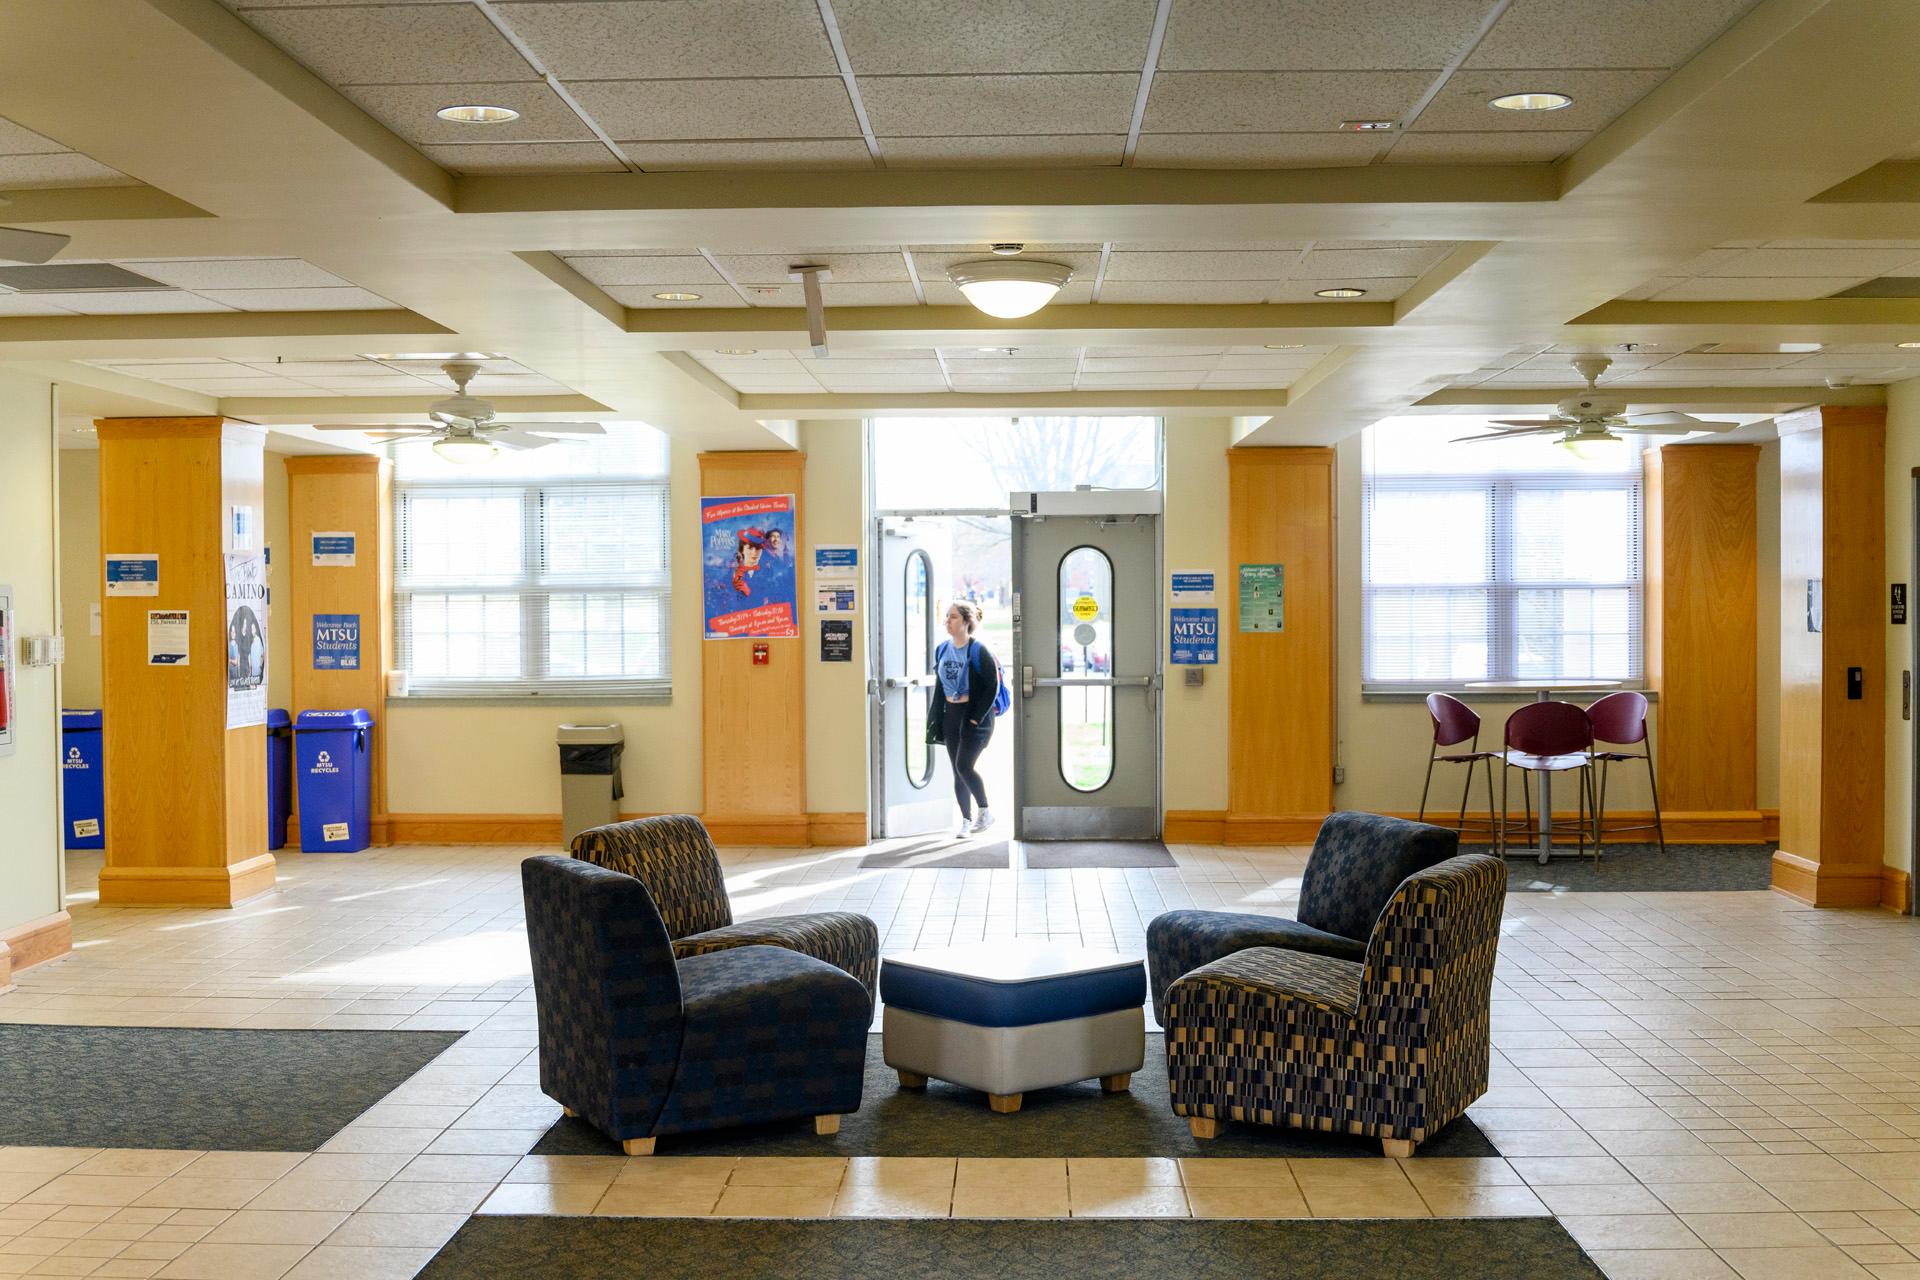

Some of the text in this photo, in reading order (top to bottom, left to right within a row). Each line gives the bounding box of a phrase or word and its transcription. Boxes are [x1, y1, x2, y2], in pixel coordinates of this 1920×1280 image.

[225, 583, 265, 600] CAMINO
[316, 629, 357, 641] MTSU
[1173, 623, 1216, 635] MTSU
[316, 641, 358, 650] Students
[1173, 635, 1215, 644] Students
